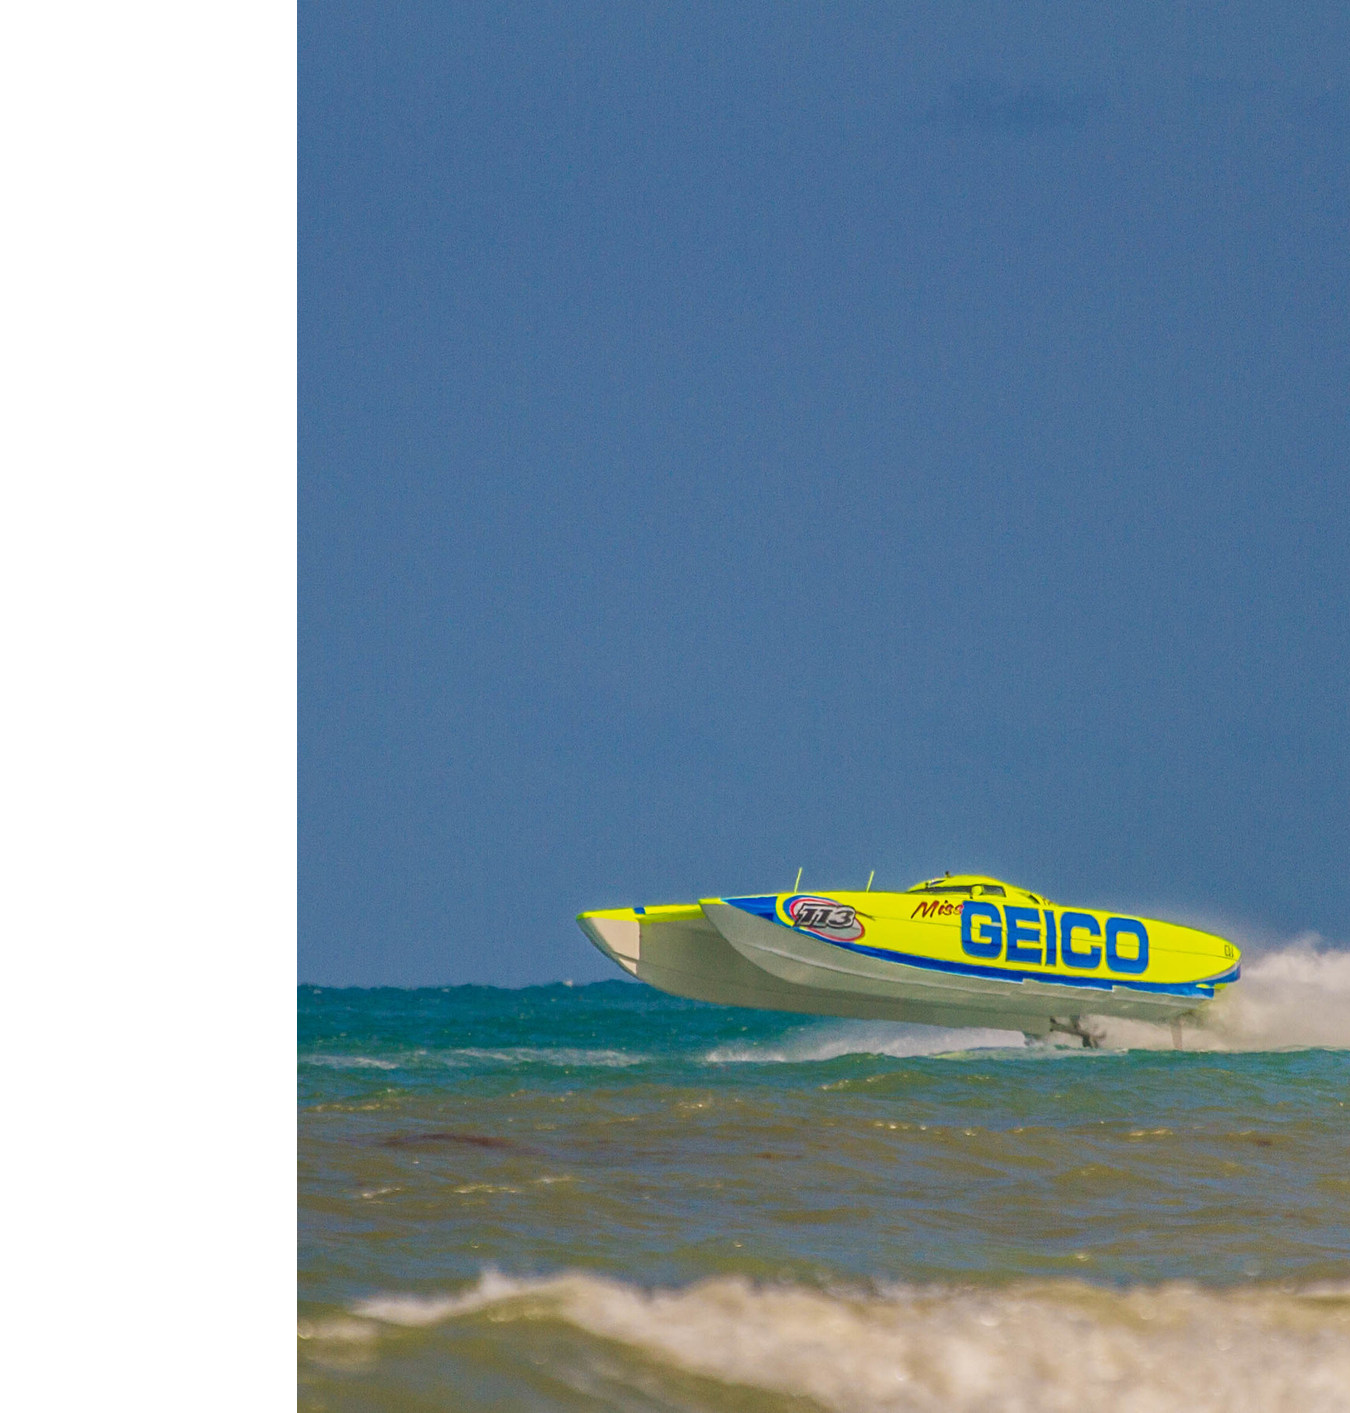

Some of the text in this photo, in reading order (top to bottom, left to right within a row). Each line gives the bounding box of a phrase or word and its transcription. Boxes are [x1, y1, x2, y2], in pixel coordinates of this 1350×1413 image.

[798, 904, 855, 928] 113
[911, 899, 1149, 975] Miss GEICO
